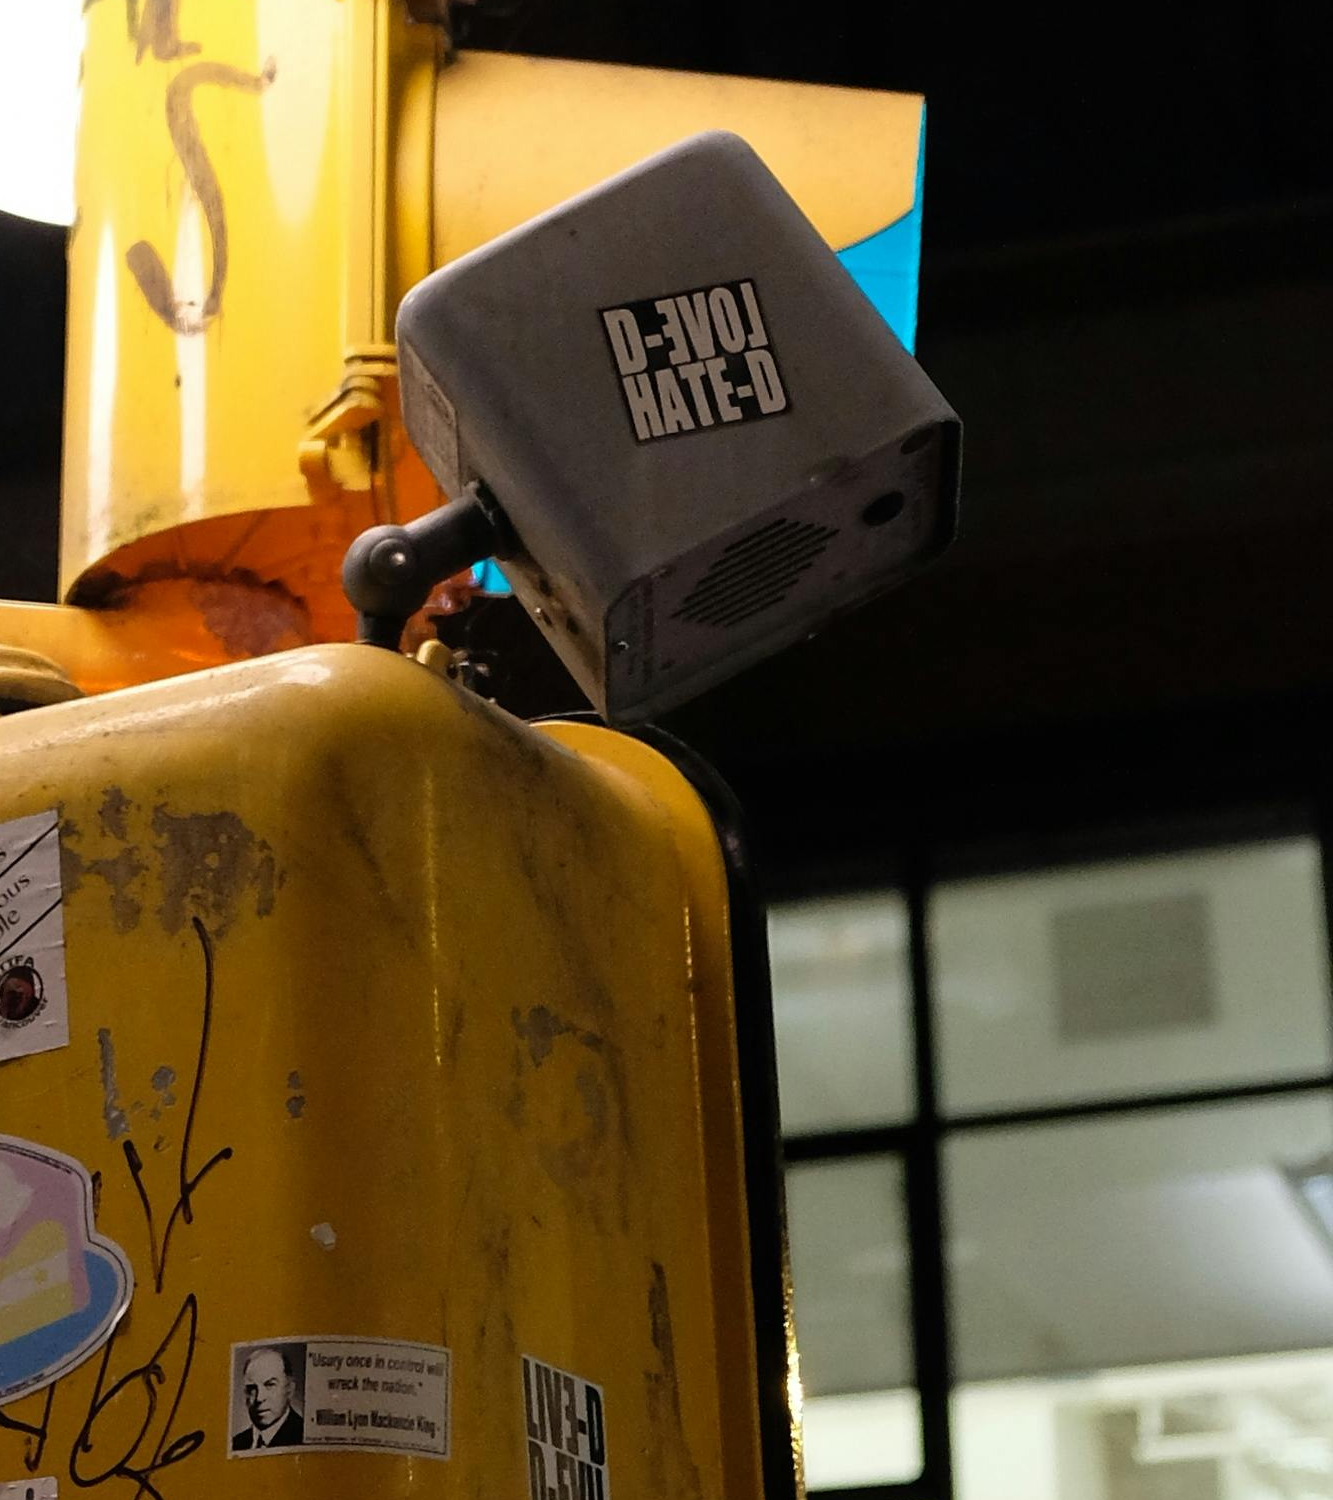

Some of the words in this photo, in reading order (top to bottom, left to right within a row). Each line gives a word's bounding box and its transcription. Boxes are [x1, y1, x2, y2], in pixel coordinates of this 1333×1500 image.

[622, 348, 787, 441] HATE-D
[345, 1355, 372, 1369] once
[374, 1353, 385, 1370] in
[361, 1376, 379, 1392] the
